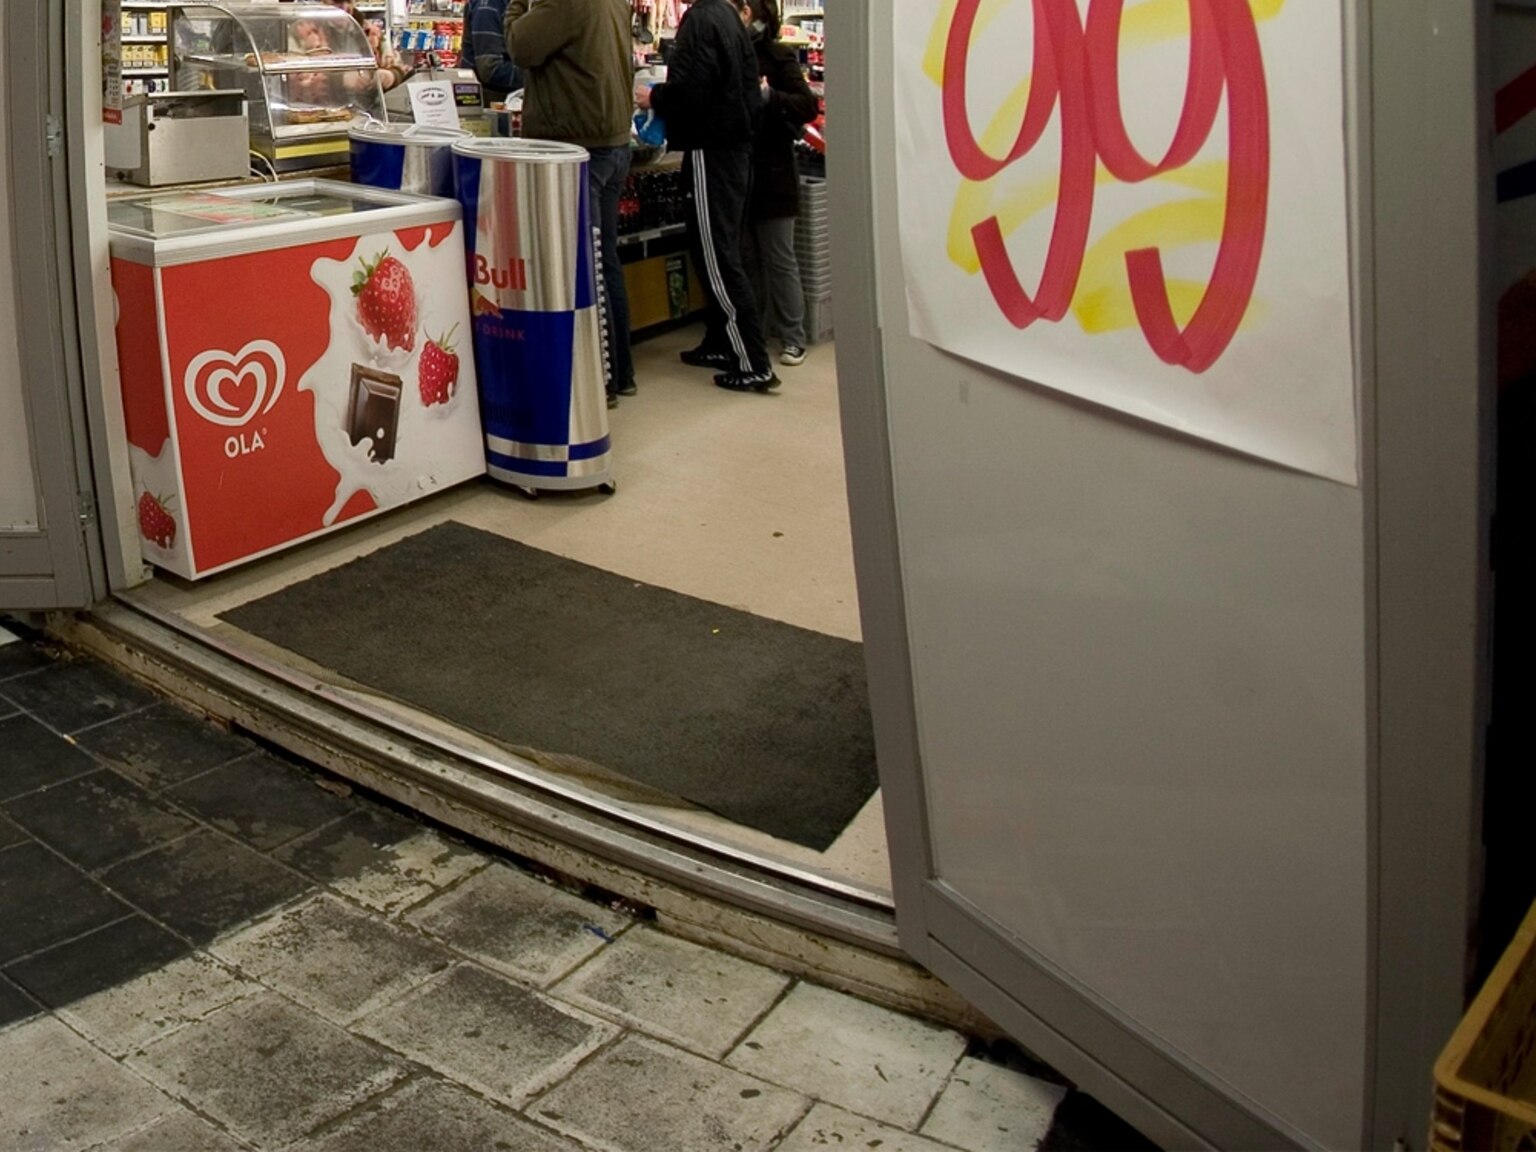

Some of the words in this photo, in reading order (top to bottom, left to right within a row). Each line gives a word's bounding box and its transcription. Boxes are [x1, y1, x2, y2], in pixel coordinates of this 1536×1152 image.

[474, 254, 527, 290] Bull
[483, 323, 526, 340] DRINK
[224, 431, 265, 459] OLA
